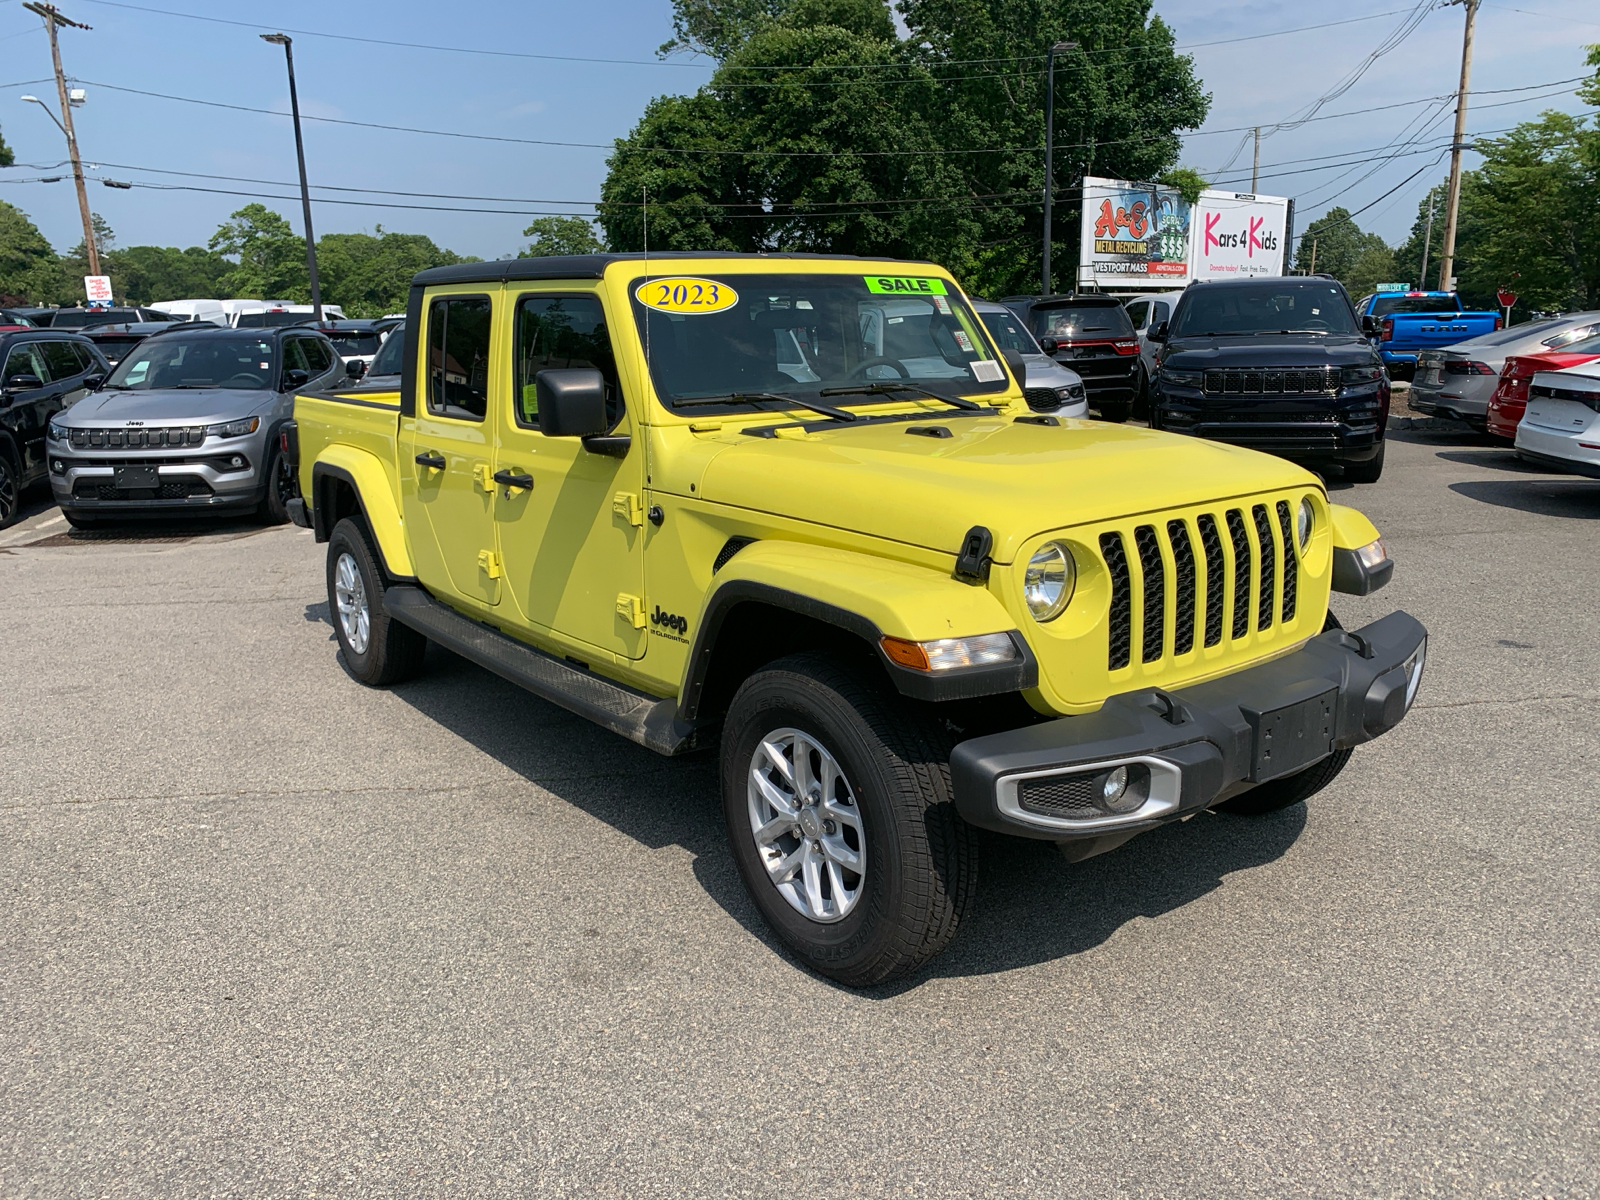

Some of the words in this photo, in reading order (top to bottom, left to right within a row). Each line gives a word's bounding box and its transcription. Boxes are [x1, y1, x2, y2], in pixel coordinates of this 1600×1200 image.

[1204, 211, 1238, 257] Kars
[1239, 229, 1247, 249] 4
[1248, 215, 1278, 259] Kids
[1095, 240, 1116, 253] METAL
[1116, 241, 1147, 254] RECYCLING
[1092, 260, 1130, 273] WESTPORT
[1130, 262, 1148, 273] MASS
[1209, 263, 1225, 272] Donate
[1225, 264, 1239, 274] today!
[877, 278, 932, 293] SALE
[656, 284, 719, 306] 2023
[1421, 325, 1468, 333] RAM
[650, 604, 688, 636] Jeep
[655, 630, 690, 646] GLADIATOR
[782, 840, 884, 962] BRIDGESTONE
